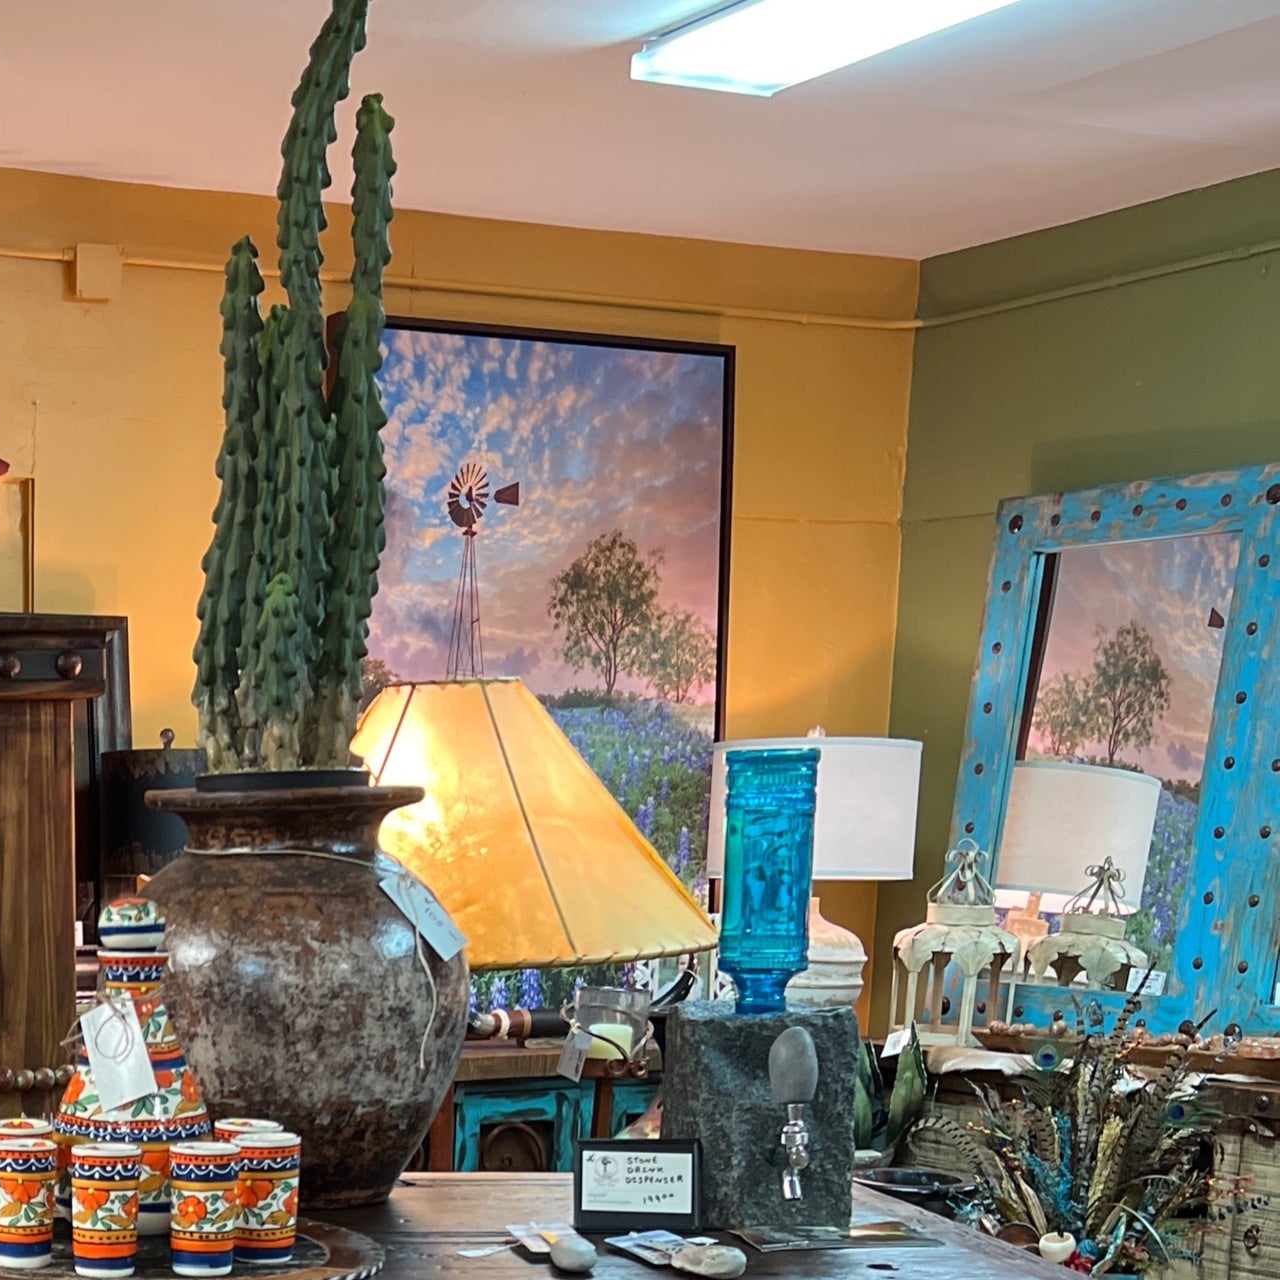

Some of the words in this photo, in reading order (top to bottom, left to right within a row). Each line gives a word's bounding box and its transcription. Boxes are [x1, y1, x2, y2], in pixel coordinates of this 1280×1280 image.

[626, 1156, 658, 1165] STONE
[627, 1166, 664, 1174] DRINK
[625, 1174, 683, 1184] DISPENSER
